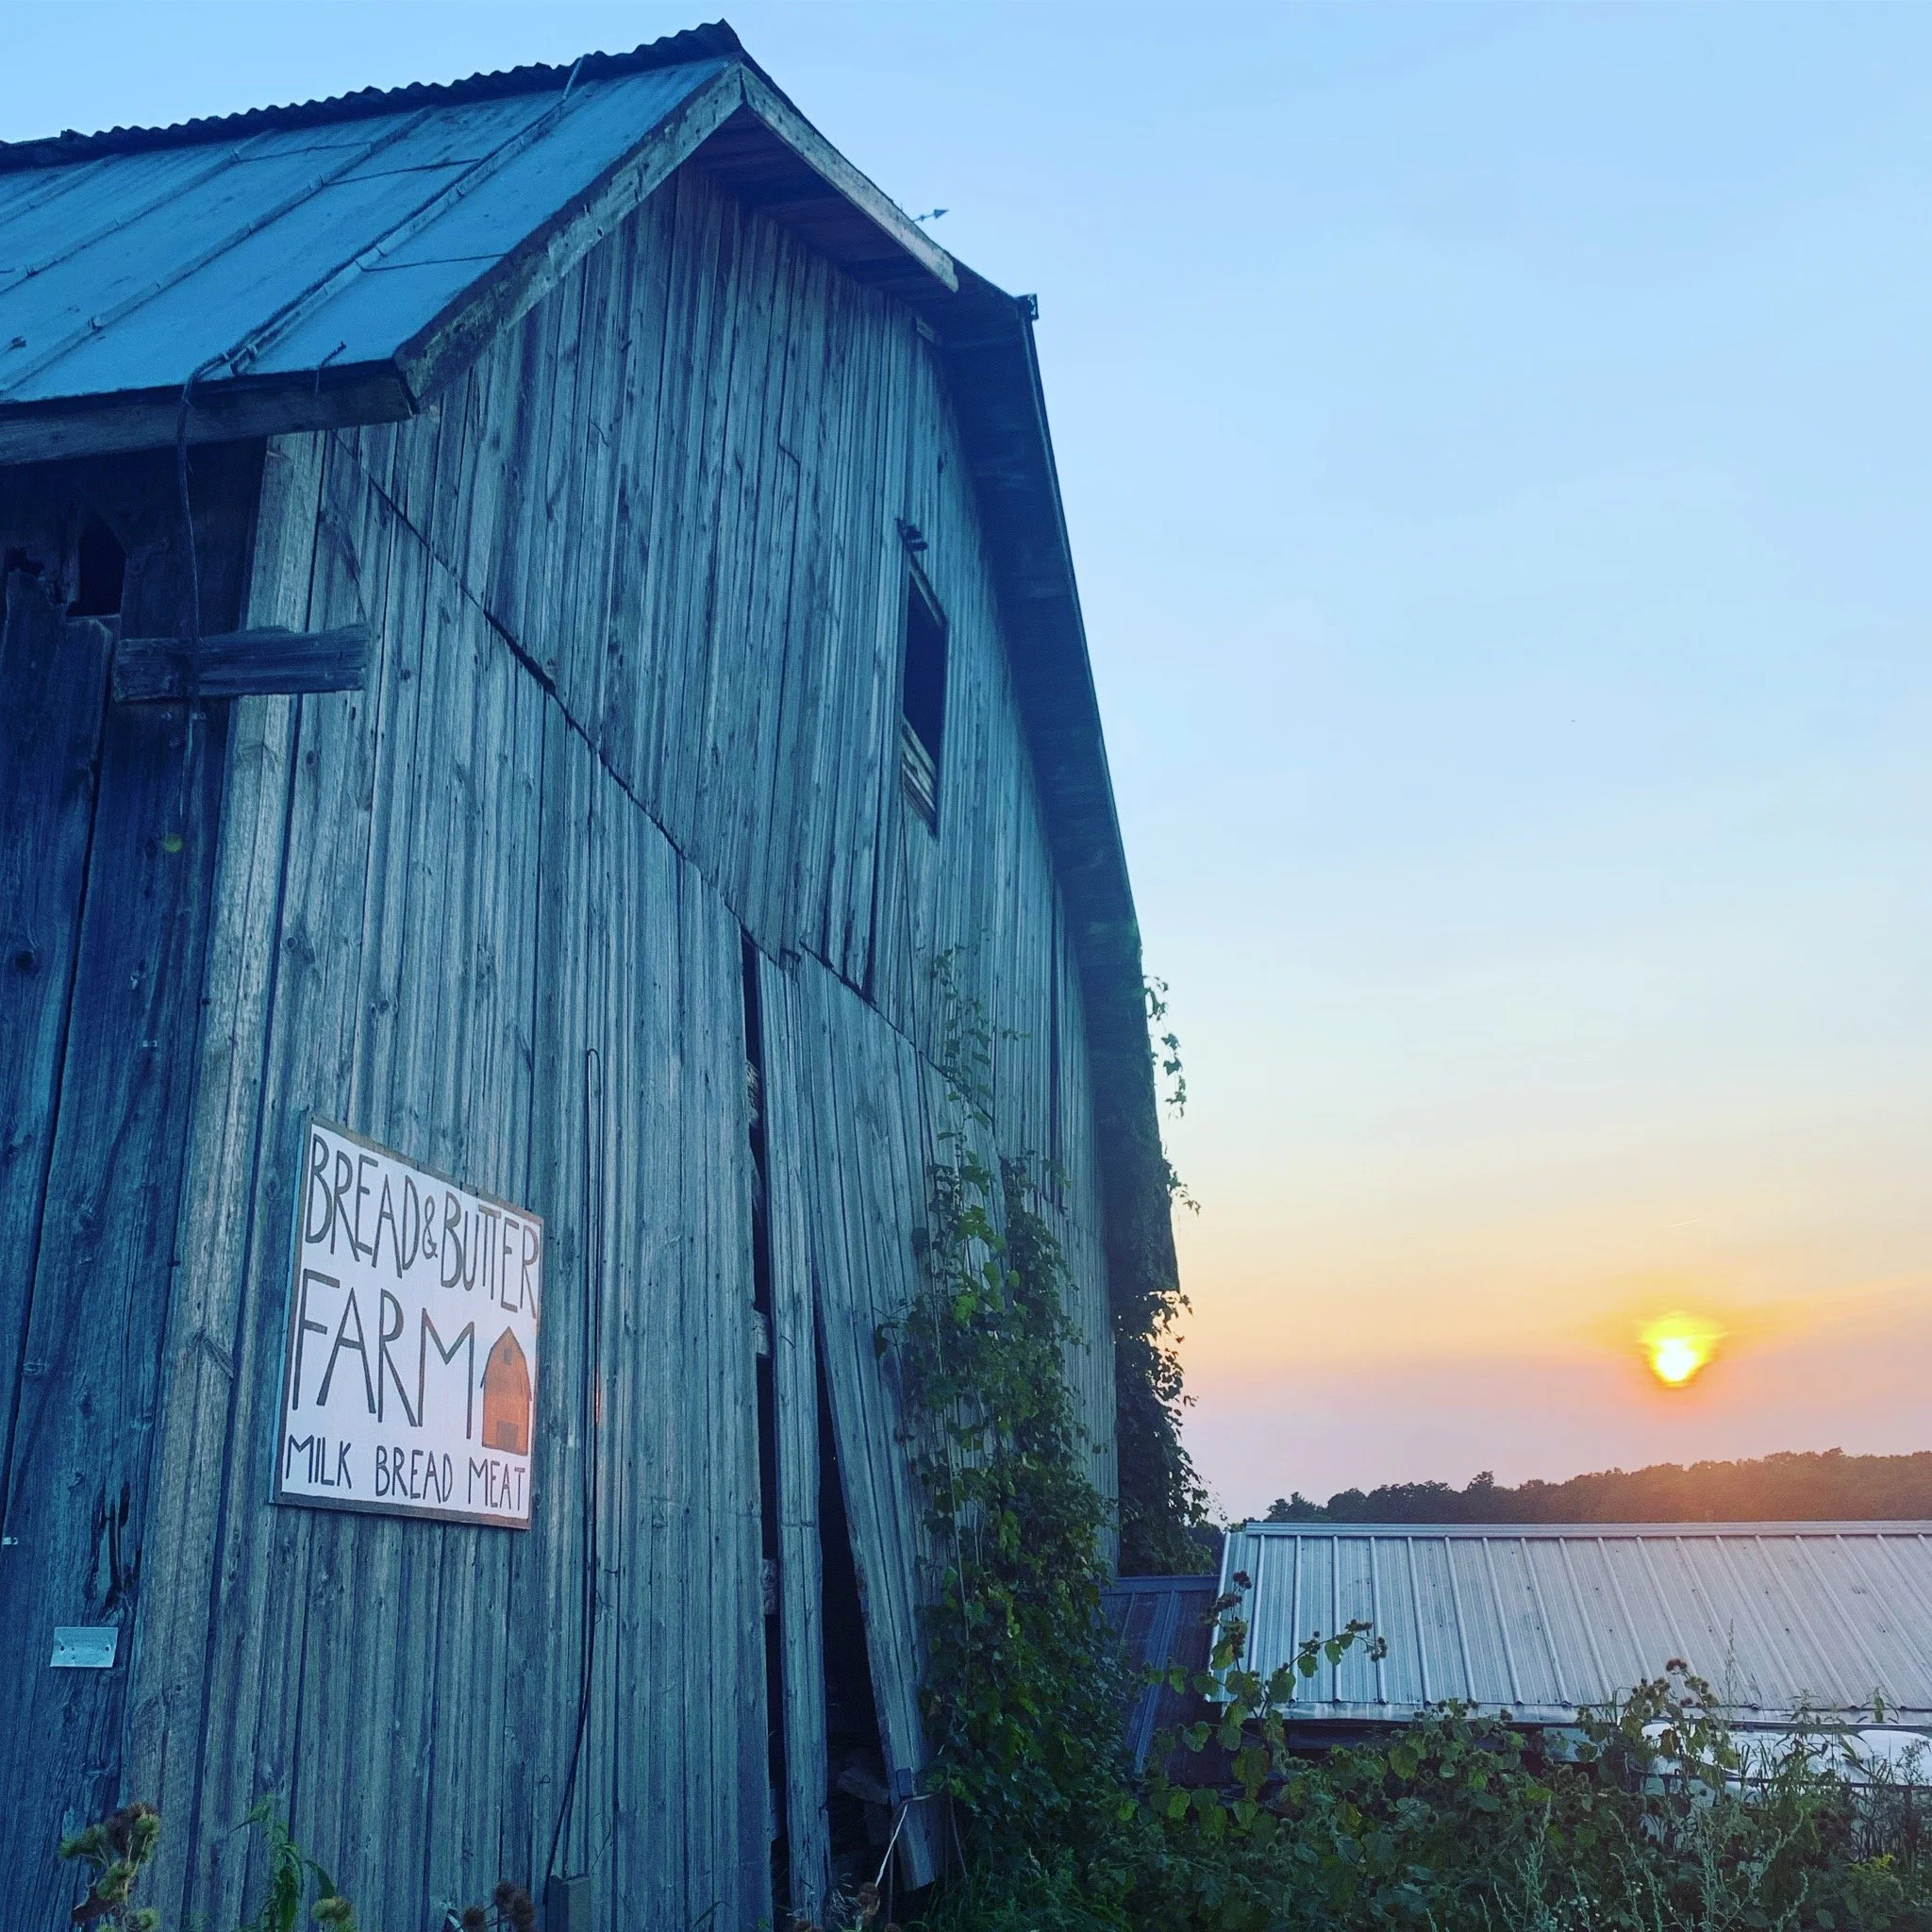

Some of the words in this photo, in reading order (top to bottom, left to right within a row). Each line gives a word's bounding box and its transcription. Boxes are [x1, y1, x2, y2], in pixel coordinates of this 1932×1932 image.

[292, 1268, 475, 1441] FARM
[286, 1434, 352, 1489] MILK
[375, 1444, 454, 1504] BREAD
[468, 1457, 525, 1511] MEAT
